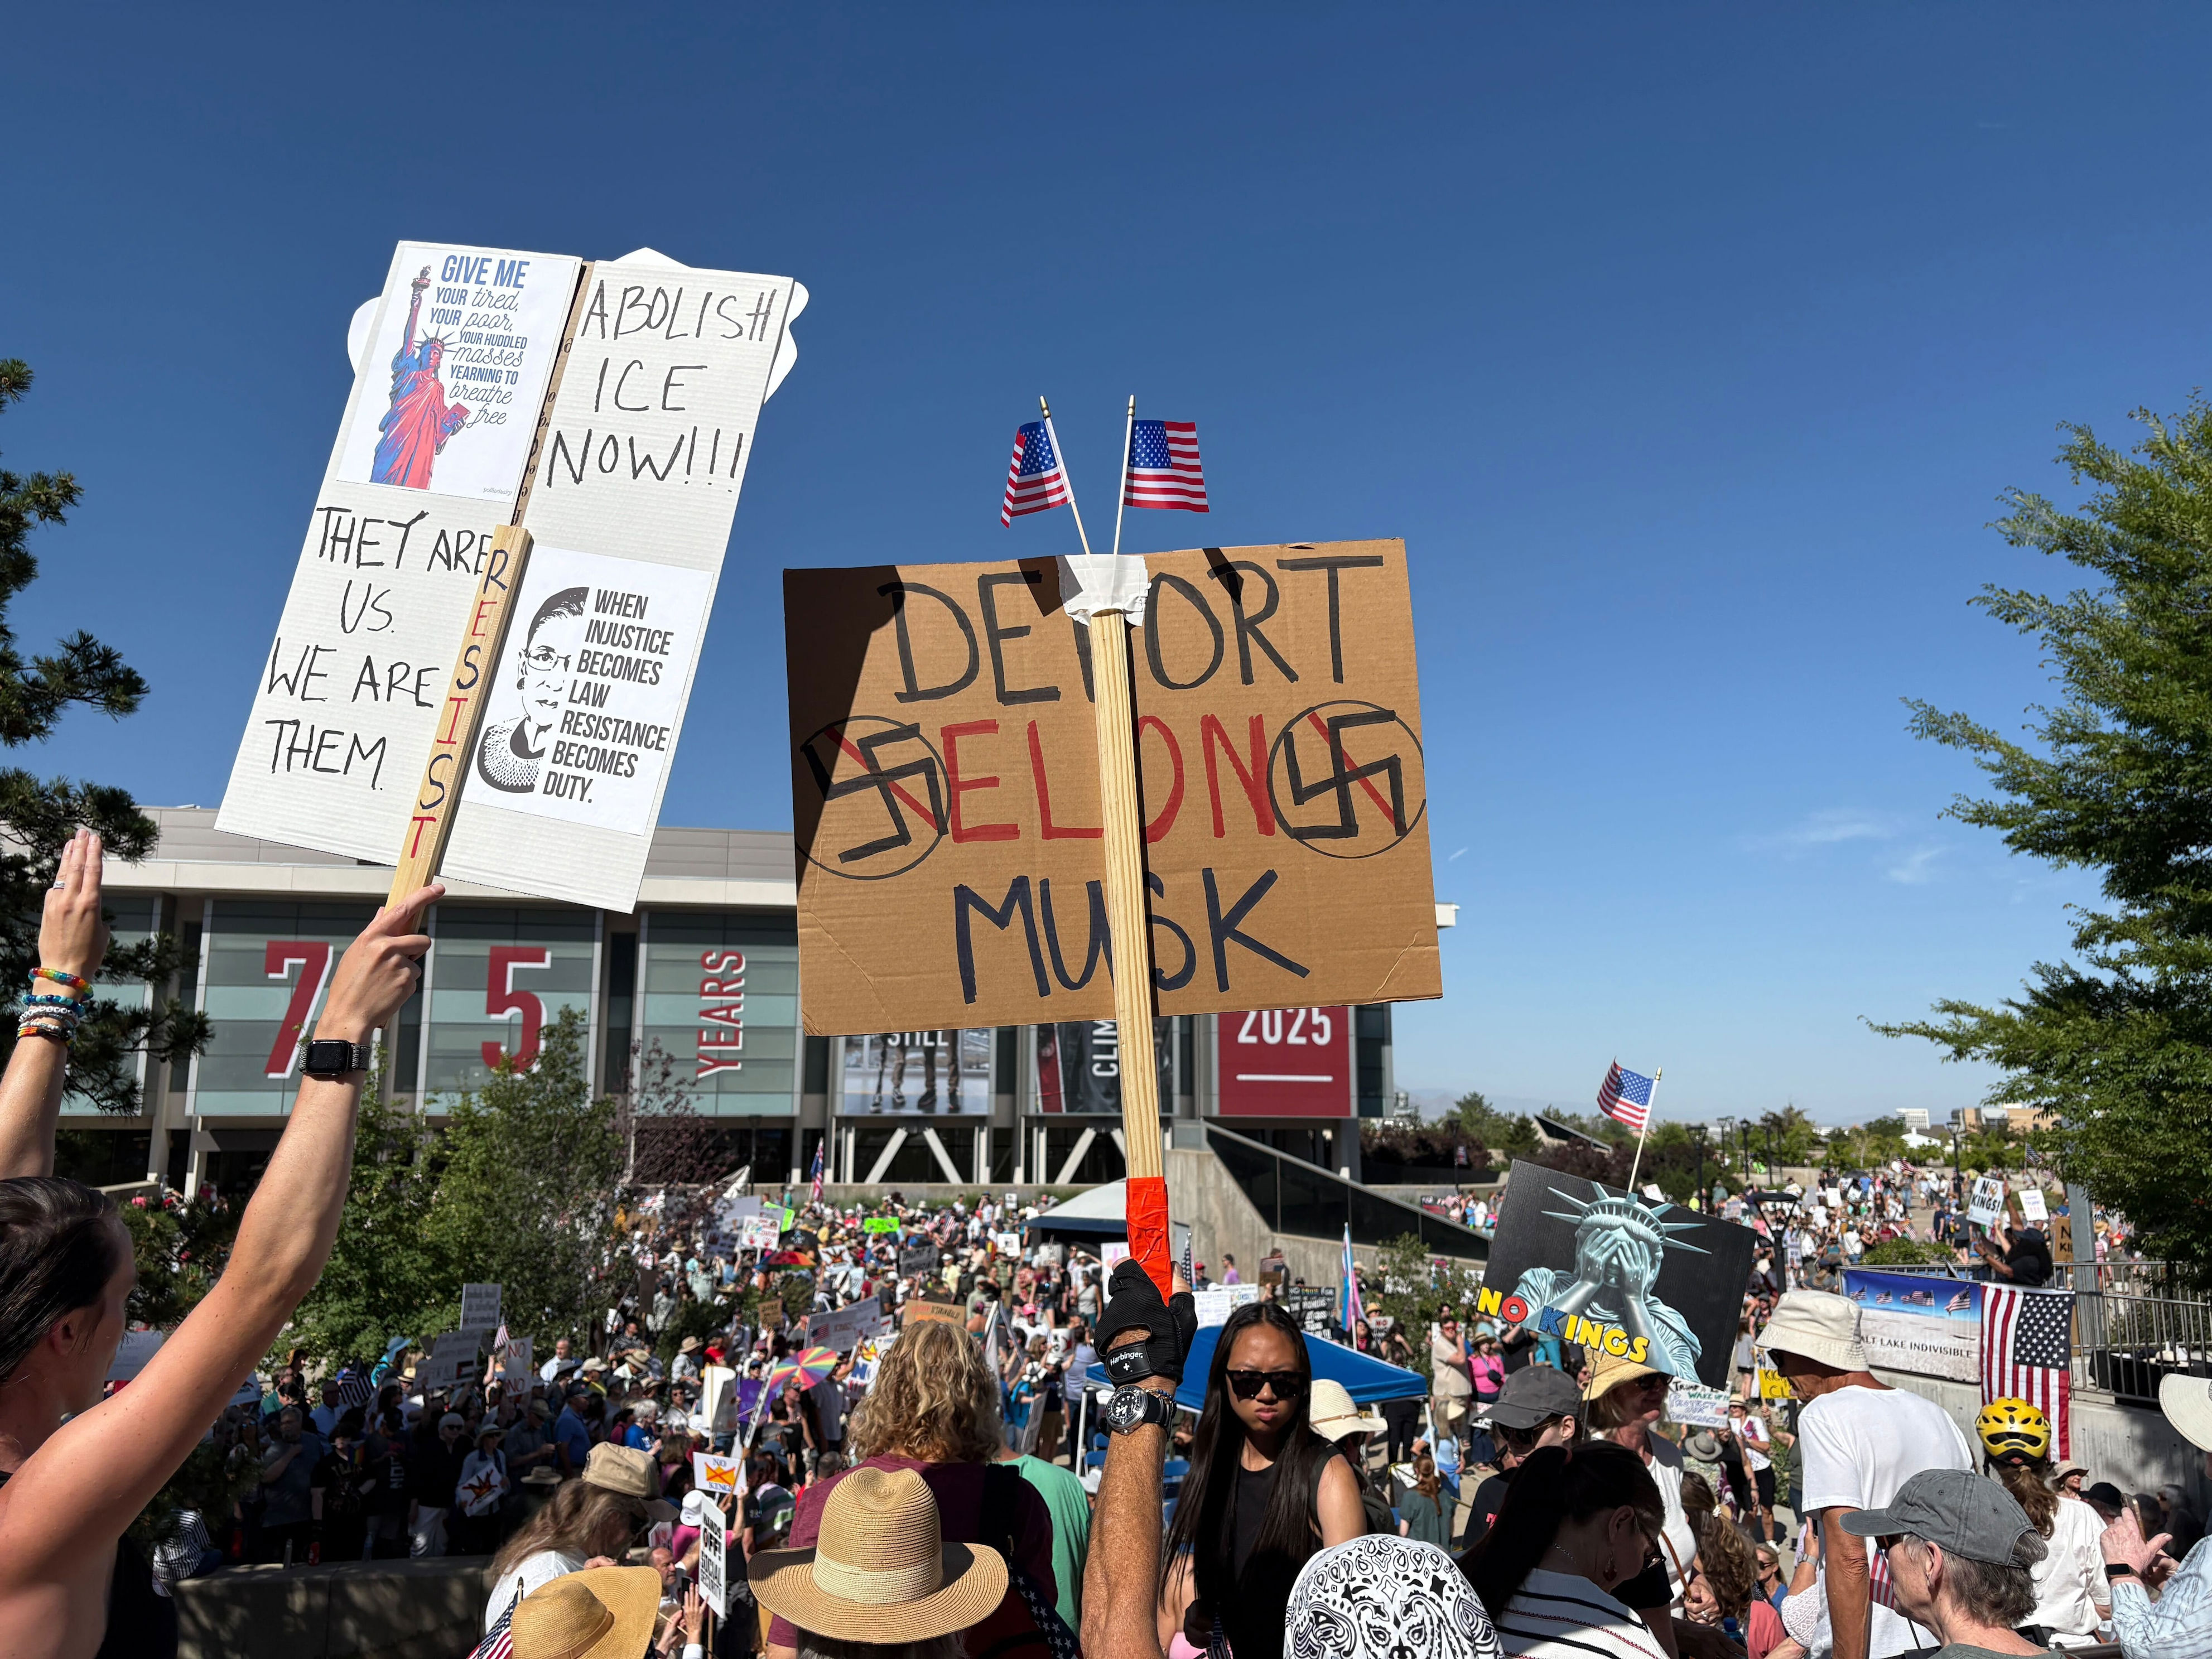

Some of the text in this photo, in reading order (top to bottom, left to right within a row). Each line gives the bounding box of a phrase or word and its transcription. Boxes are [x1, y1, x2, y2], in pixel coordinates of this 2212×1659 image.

[441, 255, 530, 288] GIVE ME
[436, 287, 520, 312] YOUR tired,
[580, 279, 777, 343] ABOLISH
[430, 307, 513, 332] YOUR poor,
[452, 346, 524, 367] masses
[460, 331, 528, 349] YOUR HUDDLED
[450, 364, 519, 385] YEARNING TO
[594, 359, 709, 413] ICE
[449, 381, 513, 404] breathe
[466, 403, 507, 428] free
[546, 428, 744, 494] NOW!!!
[316, 506, 495, 576] THEY ARE
[340, 580, 396, 635] US.
[595, 588, 648, 620] WHEN
[585, 619, 674, 656] INJUSTICE
[267, 636, 441, 708] WE ARE
[576, 649, 663, 686] BECOMES
[411, 549, 509, 859] RESIST
[568, 679, 611, 709] LAW
[560, 711, 671, 752] RESISTANCE
[265, 719, 386, 791] THEM.
[551, 741, 639, 778] BECOMES
[542, 771, 593, 804] DUTY.
[941, 713, 1276, 844] ELON
[952, 866, 1311, 1005] MUSK
[264, 941, 552, 1079] 7 5
[696, 949, 746, 1079] YEARS
[1237, 1007, 1332, 1045] 2025
[1092, 1019, 1119, 1077] CLIM
[1970, 1194, 2001, 1213] KINGS!
[1477, 1286, 1650, 1363] NO KINGS
[508, 1342, 526, 1358] NO
[1861, 1335, 1974, 1359] ALT LAKE INDIVISIBLE
[1669, 1393, 1717, 1410] PROTECT
[1688, 1391, 1713, 1400] WAKE
[712, 1458, 727, 1467] NO
[709, 1482, 732, 1492] KINGS
[703, 1512, 722, 1540] HANDS
